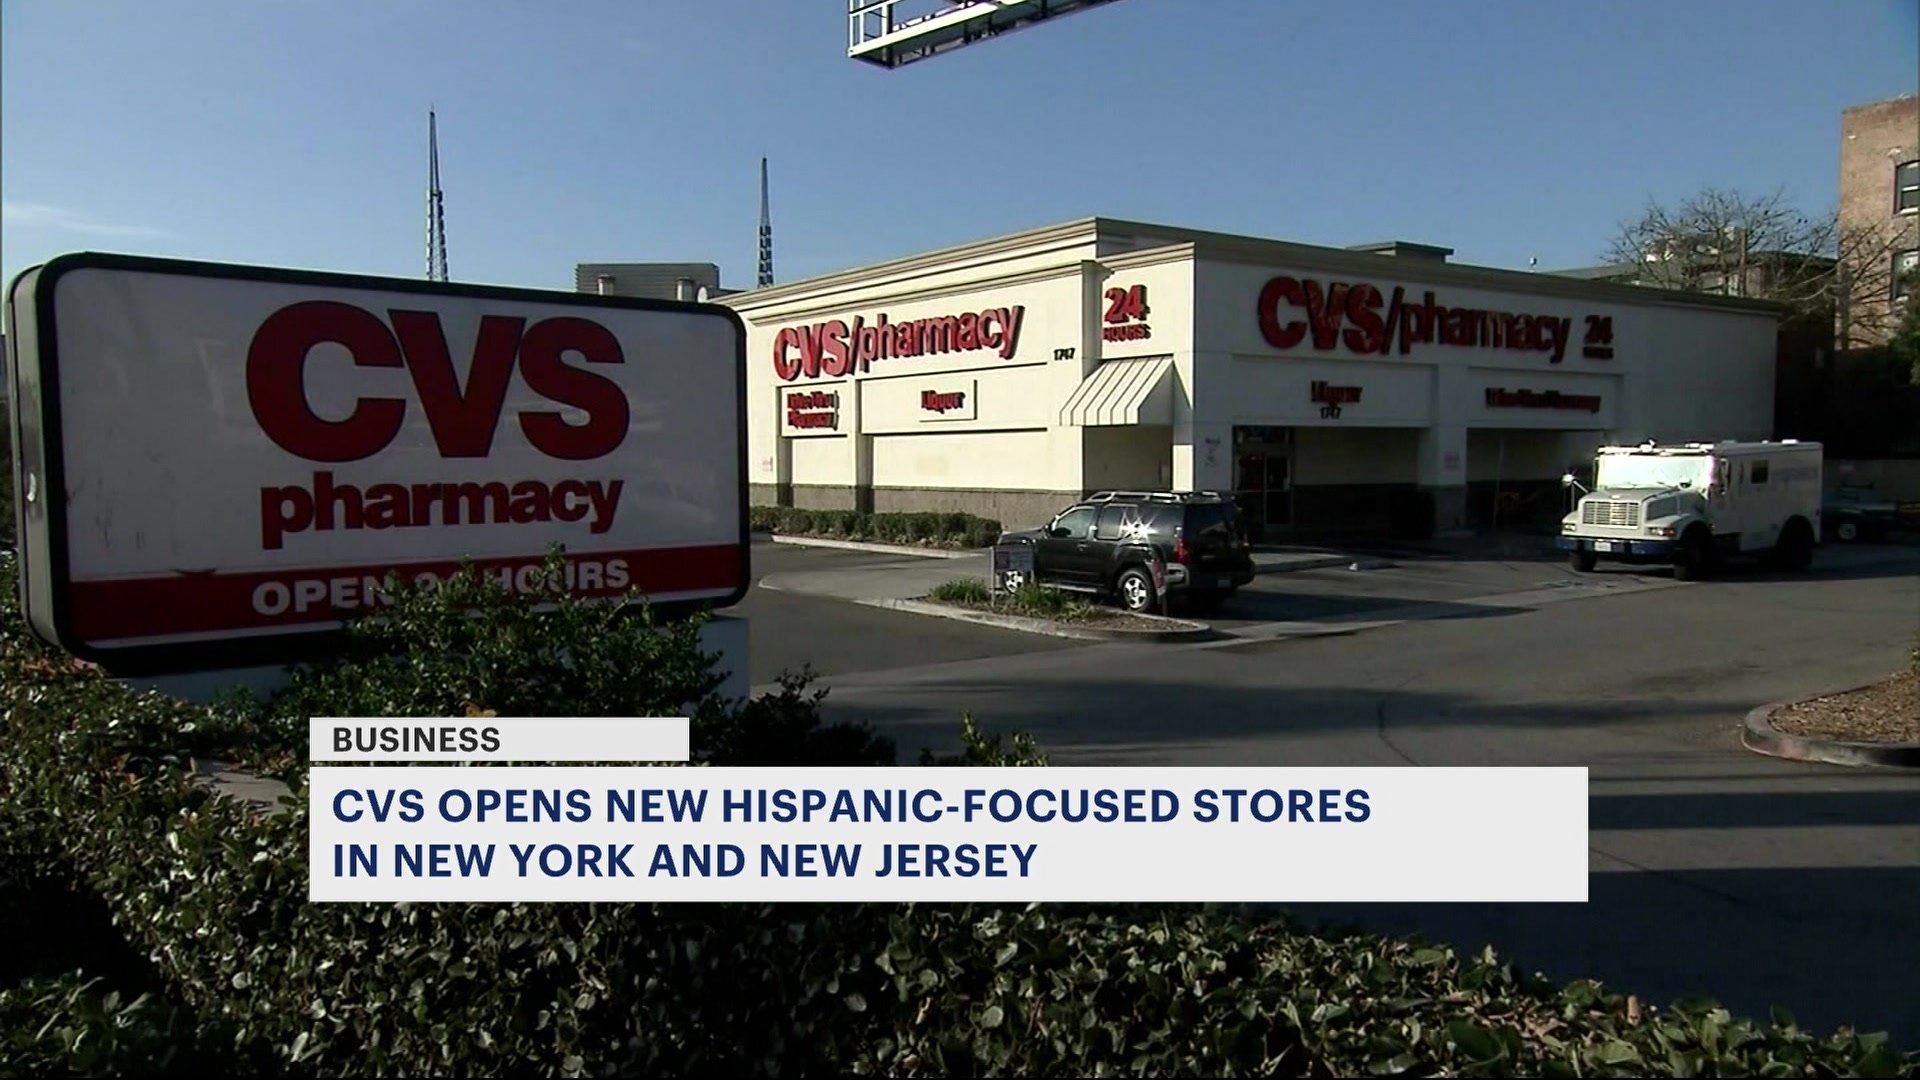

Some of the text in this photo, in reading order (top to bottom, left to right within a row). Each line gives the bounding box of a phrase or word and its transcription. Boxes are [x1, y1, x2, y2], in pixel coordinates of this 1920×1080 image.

[1102, 323, 1151, 342] HOURS
[1104, 284, 1150, 323] 24
[1257, 275, 1614, 363] CVS/pharmacy 24
[246, 299, 631, 462] CVS
[773, 305, 1025, 381] CVS/pharmacy
[260, 471, 625, 550] pharmacy
[251, 574, 397, 617] OPEN
